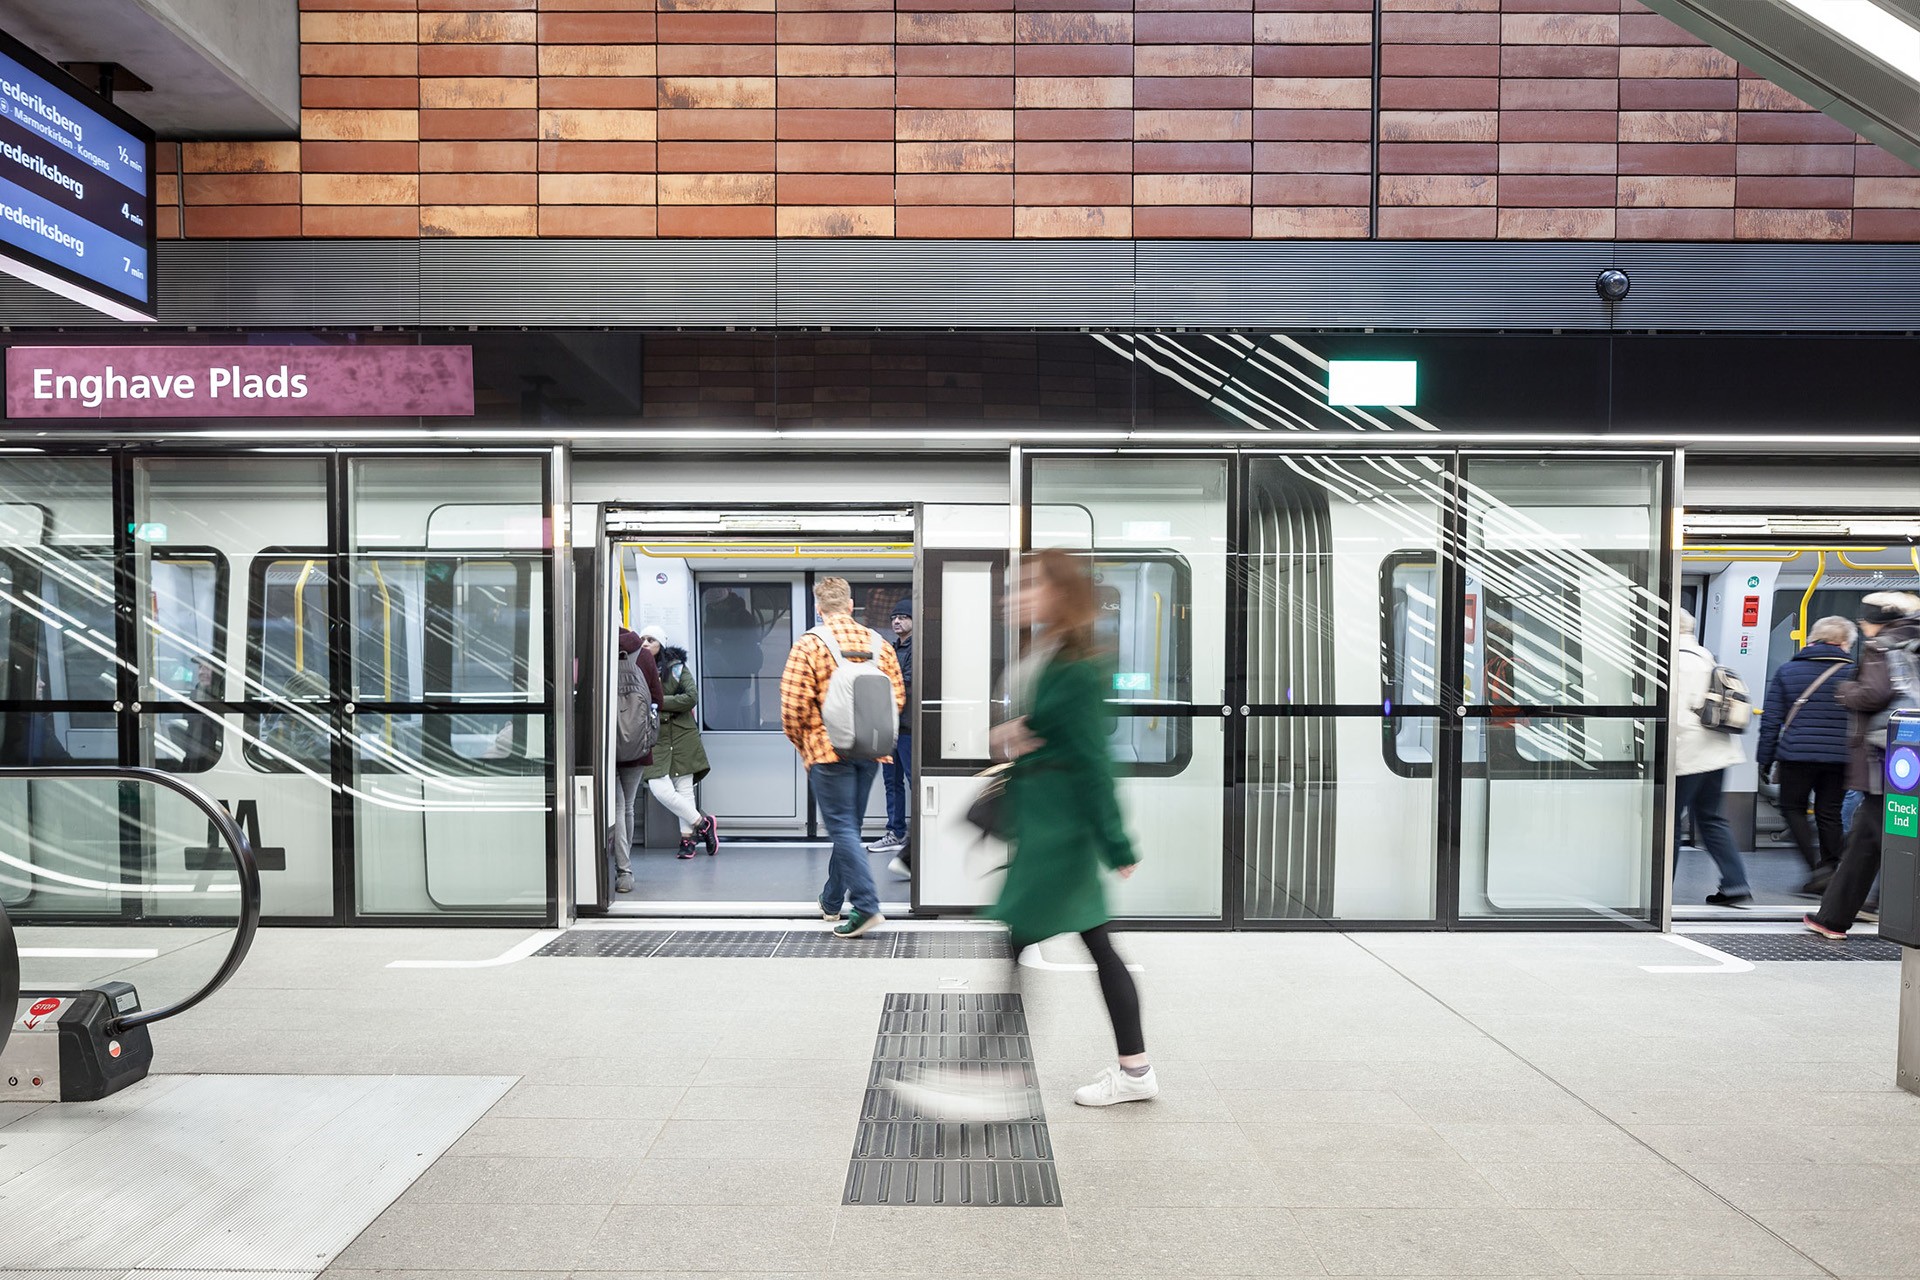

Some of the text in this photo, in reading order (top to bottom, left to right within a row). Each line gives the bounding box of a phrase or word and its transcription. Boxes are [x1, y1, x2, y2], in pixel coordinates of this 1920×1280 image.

[0, 78, 83, 142] ederiksberg
[14, 107, 110, 171] Marmorkirken Kongens
[129, 157, 143, 173] min
[121, 203, 144, 227] 4 min
[123, 256, 144, 280] 7 min
[33, 365, 308, 408] Enghave Plads
[1887, 800, 1917, 815] Check
[1893, 814, 1909, 827] ind
[33, 1003, 56, 1011] STOP
